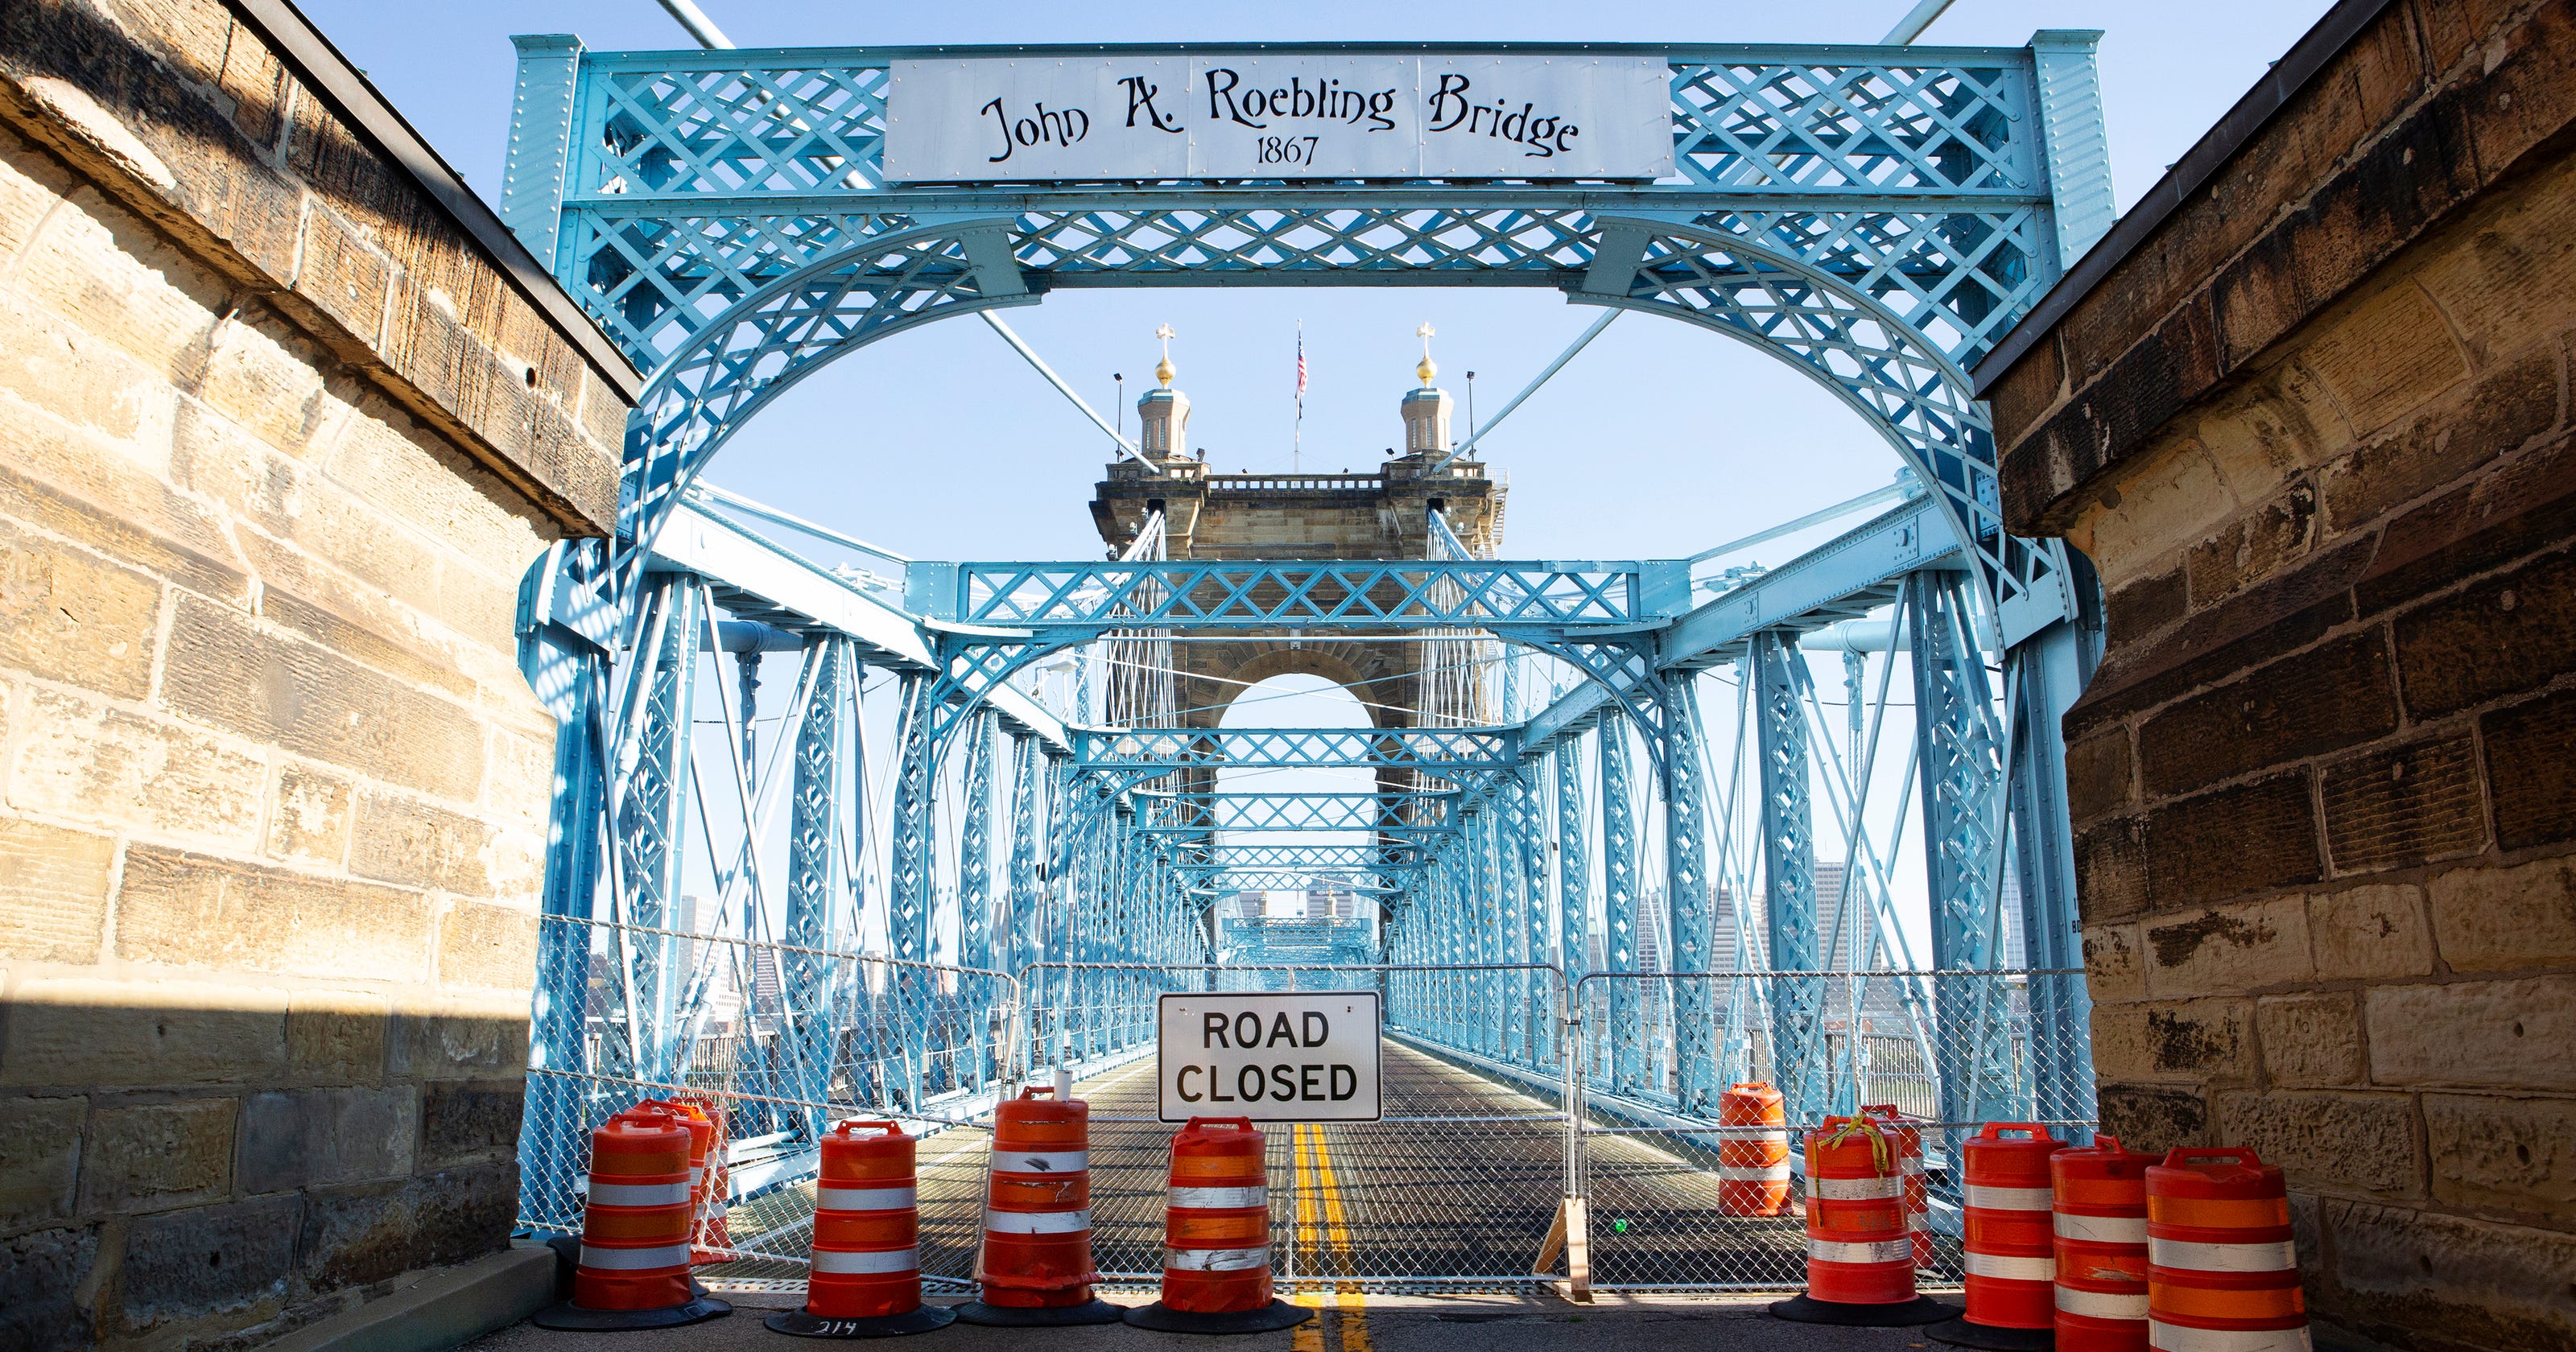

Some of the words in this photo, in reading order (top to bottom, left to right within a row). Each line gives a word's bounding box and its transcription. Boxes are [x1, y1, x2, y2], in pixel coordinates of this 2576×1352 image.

[980, 97, 1089, 163] John
[1117, 76, 1185, 134] A.
[1205, 68, 1396, 132] Roebling
[1428, 73, 1579, 158] Bridge
[1257, 135, 1319, 167] 1867
[1203, 1011, 1329, 1049] ROAD
[1176, 1064, 1357, 1103] CLOSED
[815, 1321, 857, 1335] 214
